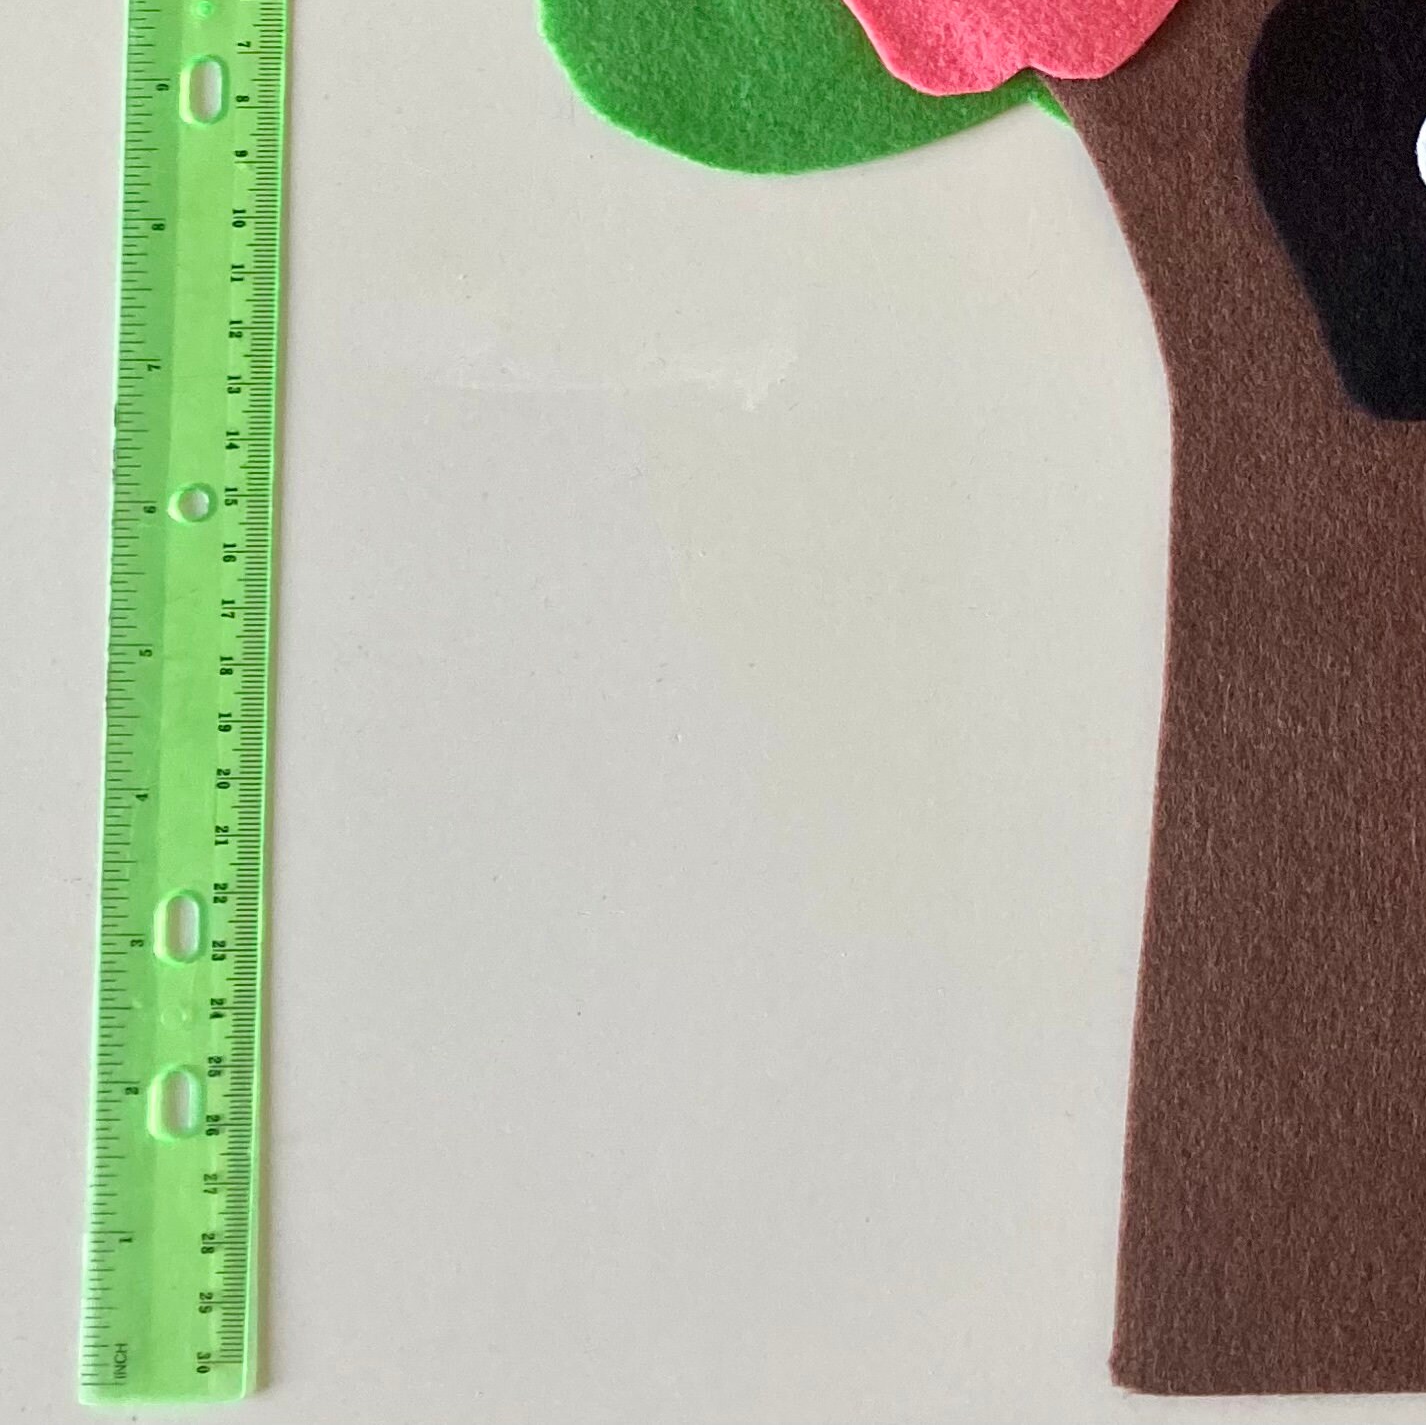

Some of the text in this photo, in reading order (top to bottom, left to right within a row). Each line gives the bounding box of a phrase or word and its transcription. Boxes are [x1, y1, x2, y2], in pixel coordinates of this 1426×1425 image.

[236, 40, 251, 49] 7
[156, 83, 169, 92] 9
[151, 222, 165, 231] 8
[147, 363, 161, 372] 7
[143, 505, 156, 514] 6
[139, 648, 152, 658] 5
[135, 793, 149, 802] 4
[130, 939, 144, 949] 3
[125, 1086, 139, 1095] 2
[114, 1343, 128, 1380] INCH
